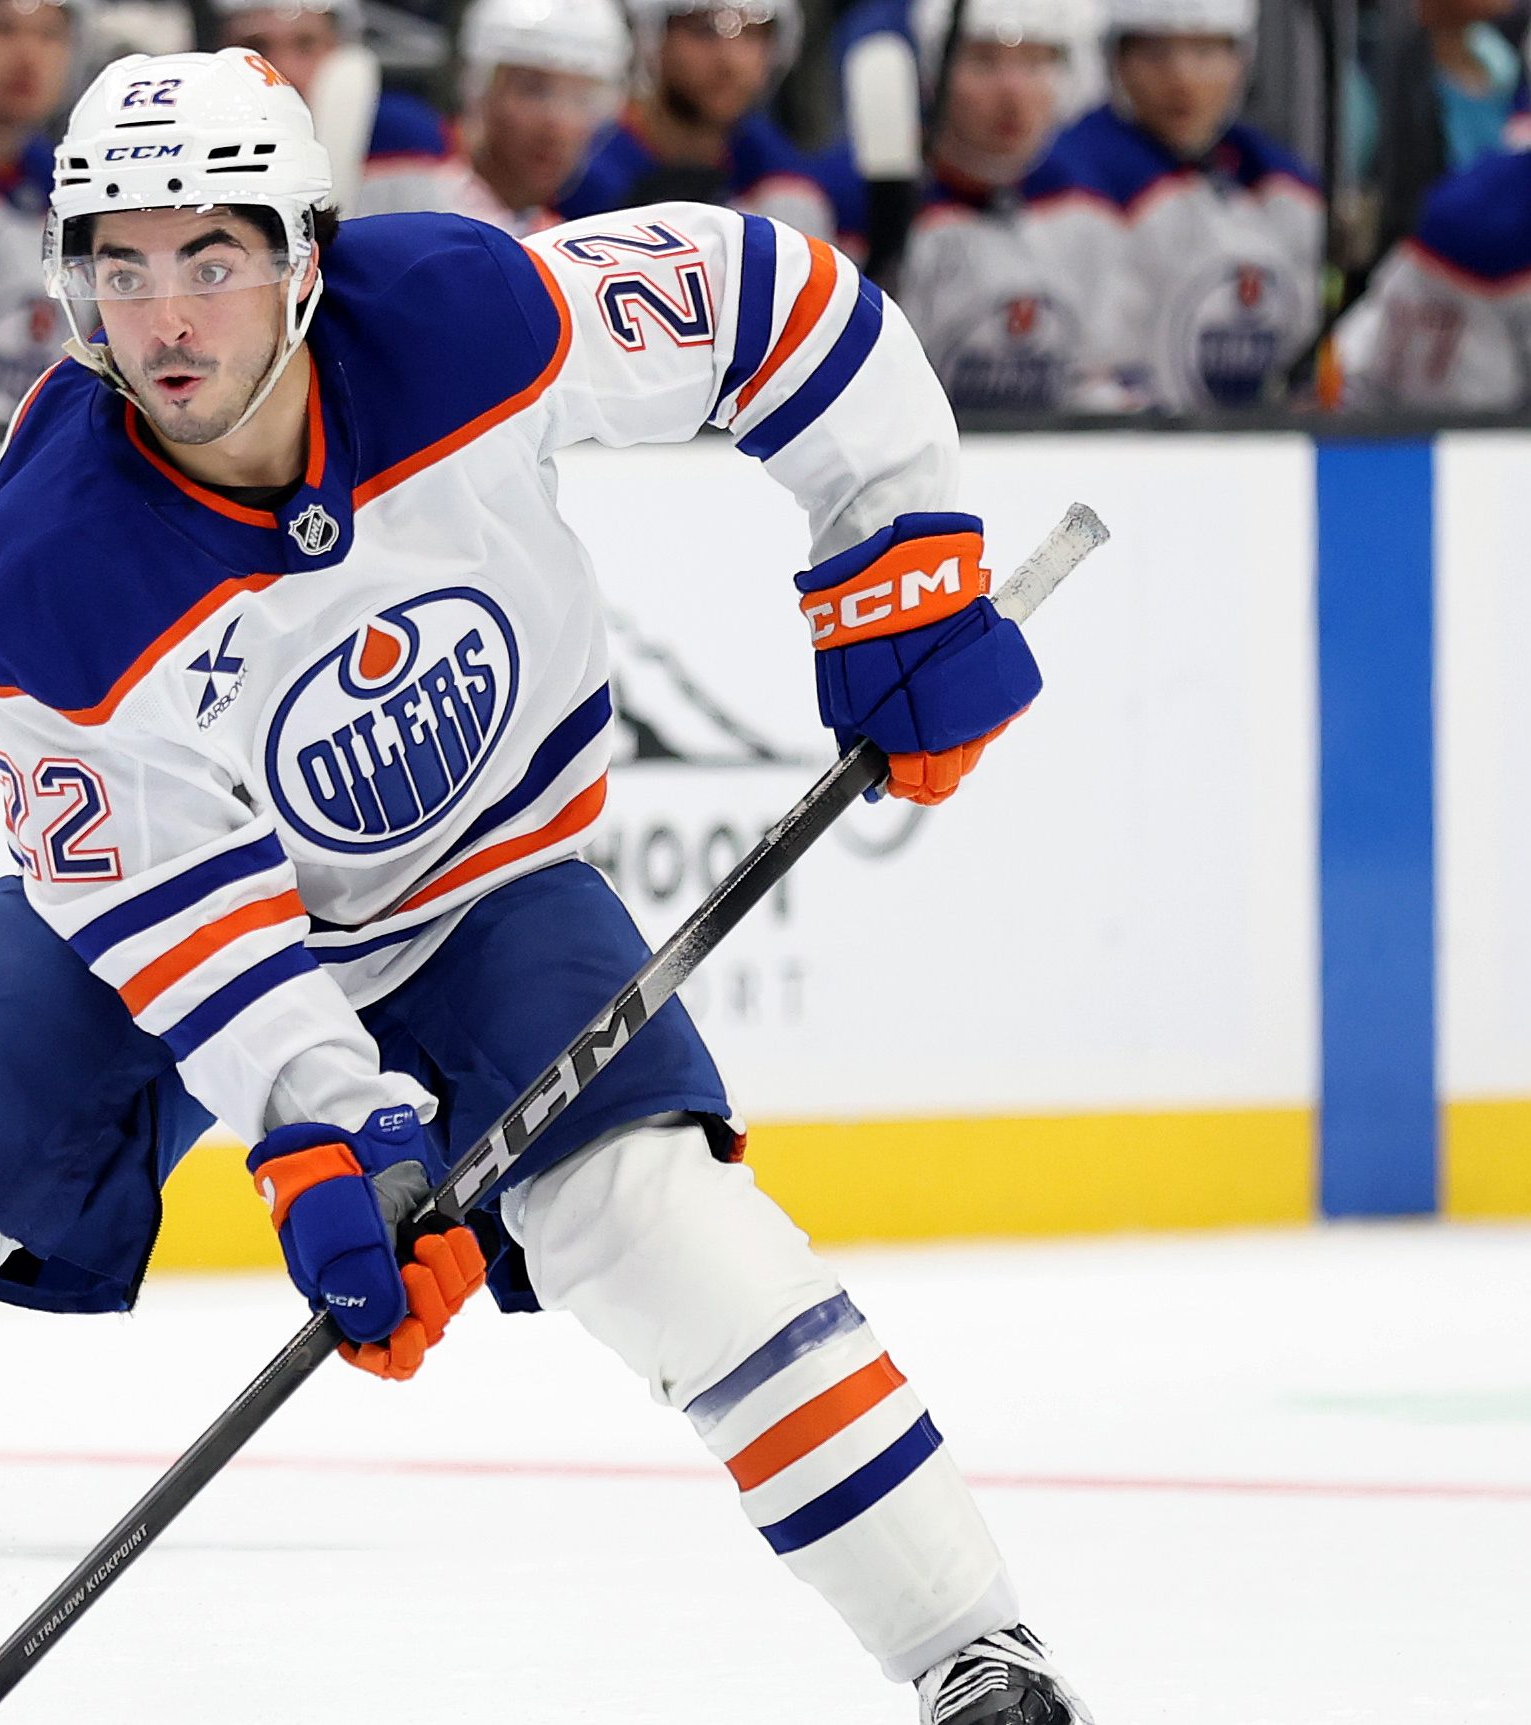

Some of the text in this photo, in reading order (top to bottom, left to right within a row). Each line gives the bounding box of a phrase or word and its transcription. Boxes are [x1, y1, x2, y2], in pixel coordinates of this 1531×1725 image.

[120, 78, 183, 110] 22
[104, 143, 184, 161] CCM
[552, 220, 715, 352] 22
[804, 556, 961, 641] CCM
[297, 628, 497, 836] OILERS
[434, 981, 648, 1221] CCM
[326, 1292, 367, 1308] CCM
[23, 1522, 150, 1657] ULTRALOW KICKPOINT
